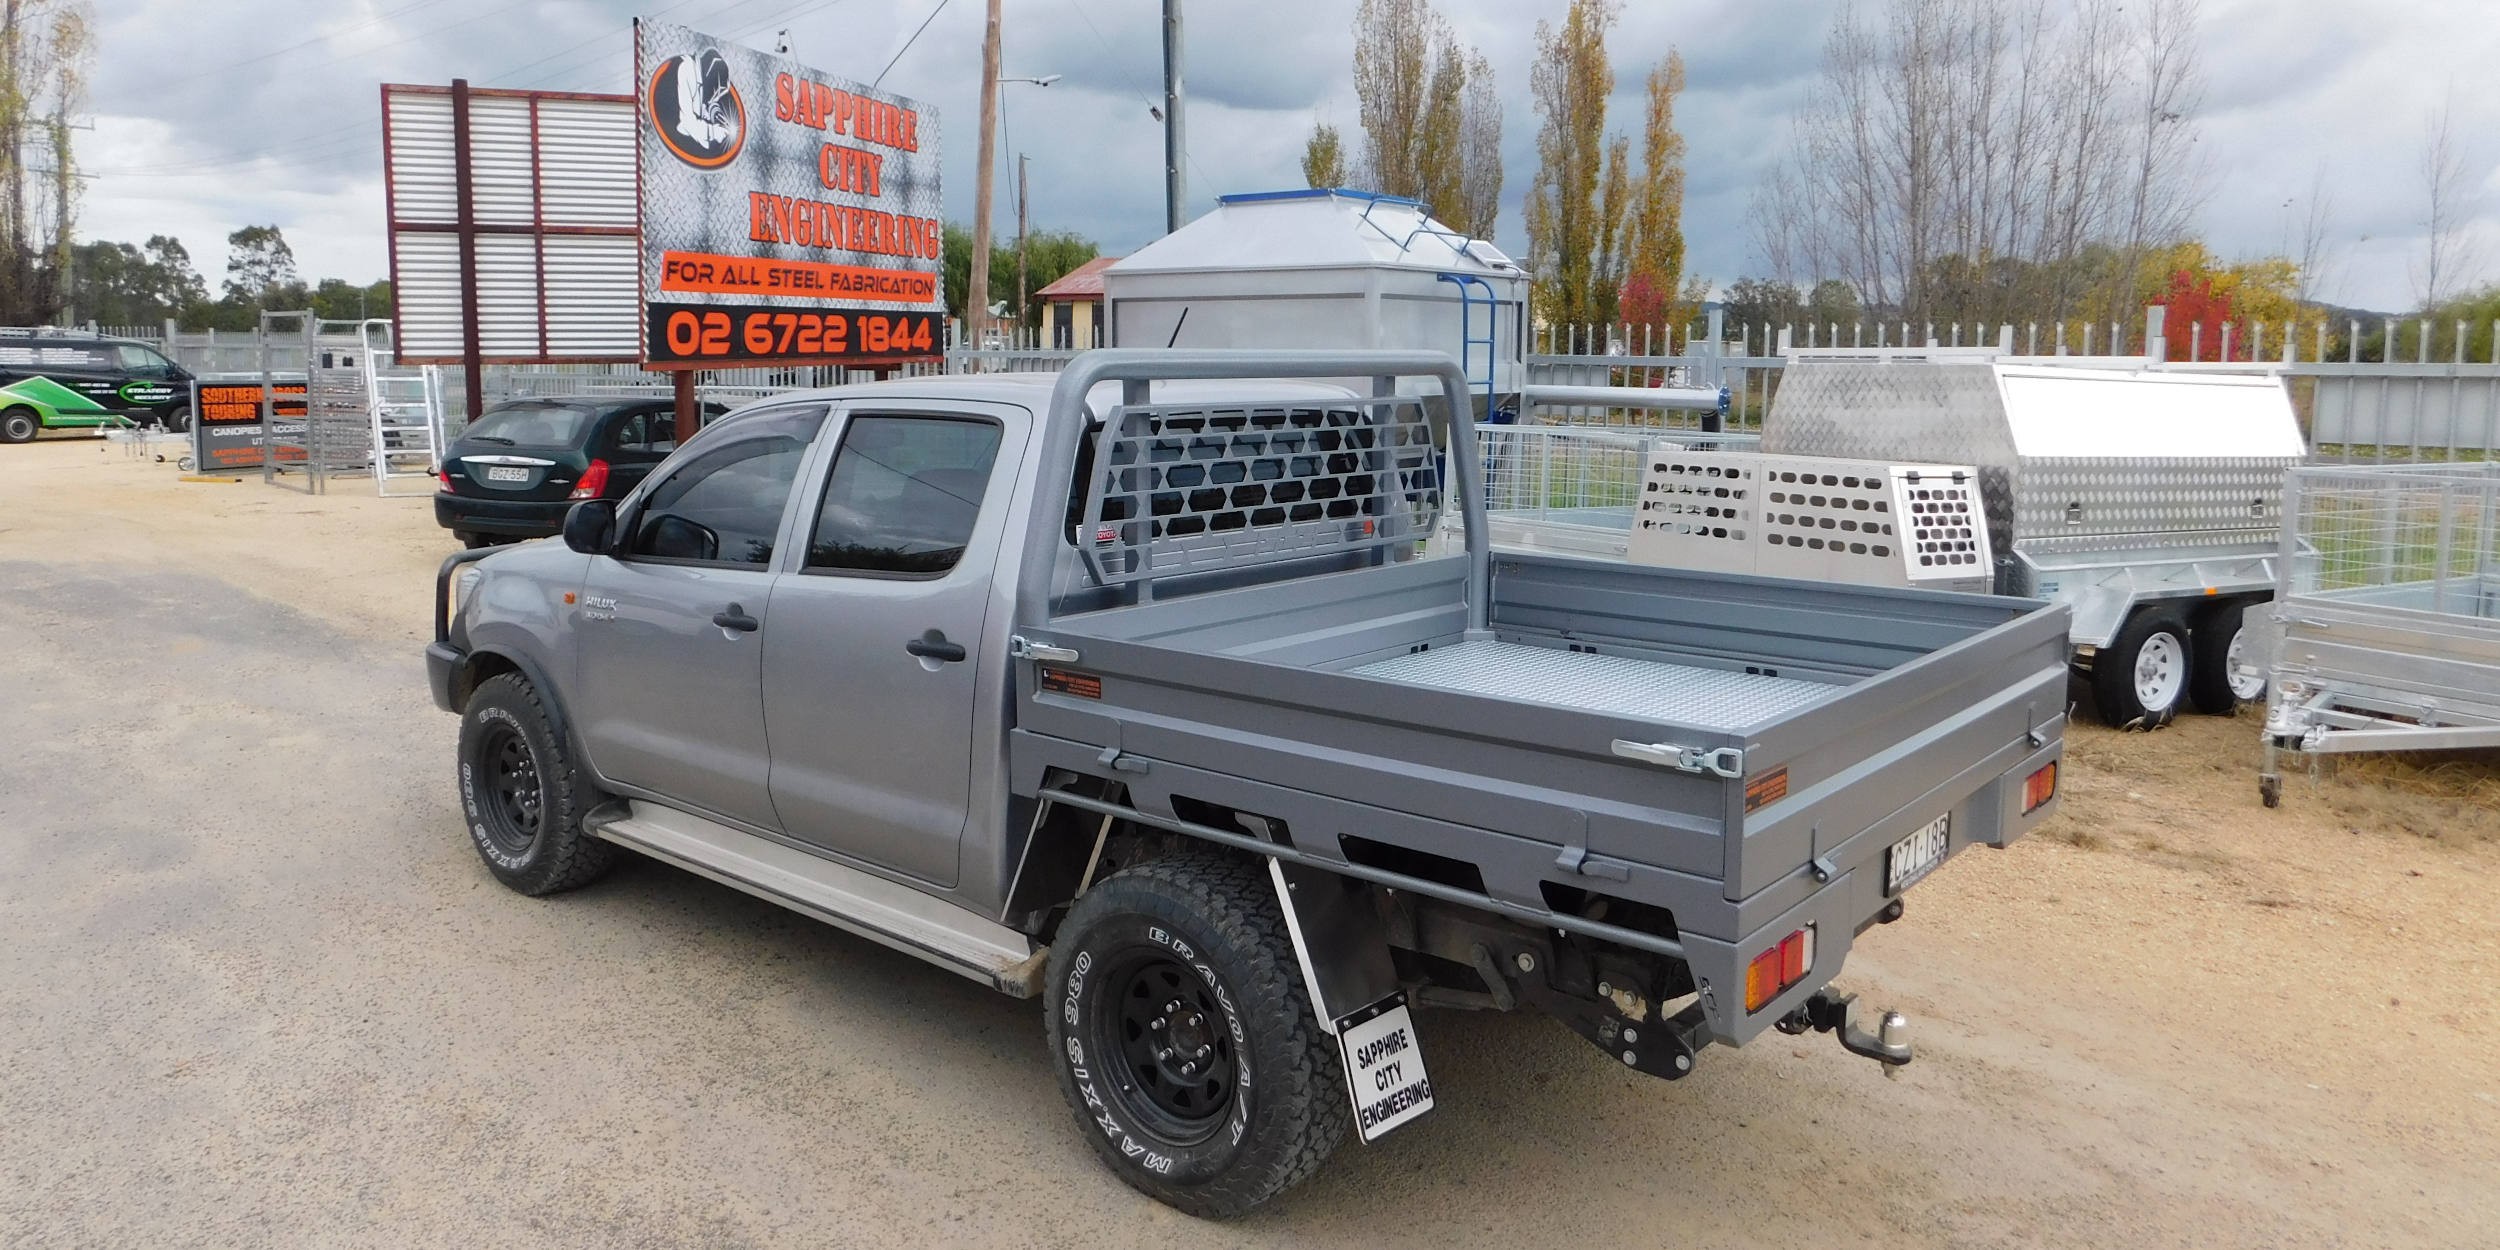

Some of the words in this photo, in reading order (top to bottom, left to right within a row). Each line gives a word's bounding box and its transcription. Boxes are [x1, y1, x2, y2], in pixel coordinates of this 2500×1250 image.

[775, 72, 918, 152] SAPPHIRE
[818, 142, 883, 197] CITY
[749, 191, 939, 260] ENGINEERING
[666, 260, 715, 285] FOR
[720, 263, 760, 286] ALL
[768, 268, 824, 290] STEEL
[830, 273, 935, 296] FABRICATION
[666, 310, 732, 356] 02
[743, 312, 848, 355] 6722
[856, 315, 934, 353] 1844
[202, 403, 256, 420] TOURING
[212, 426, 262, 437] CANOPIES
[586, 596, 617, 611] HILUX
[1064, 951, 1092, 1026] 980
[1149, 926, 1244, 1043] BRAVO
[1231, 1054, 1250, 1147] A/T
[1357, 1027, 1409, 1070] SAPPHIRE
[1374, 1059, 1402, 1091] CITY
[1065, 1036, 1173, 1174] MAXXIS
[1361, 1078, 1431, 1130] ENGINEERING
